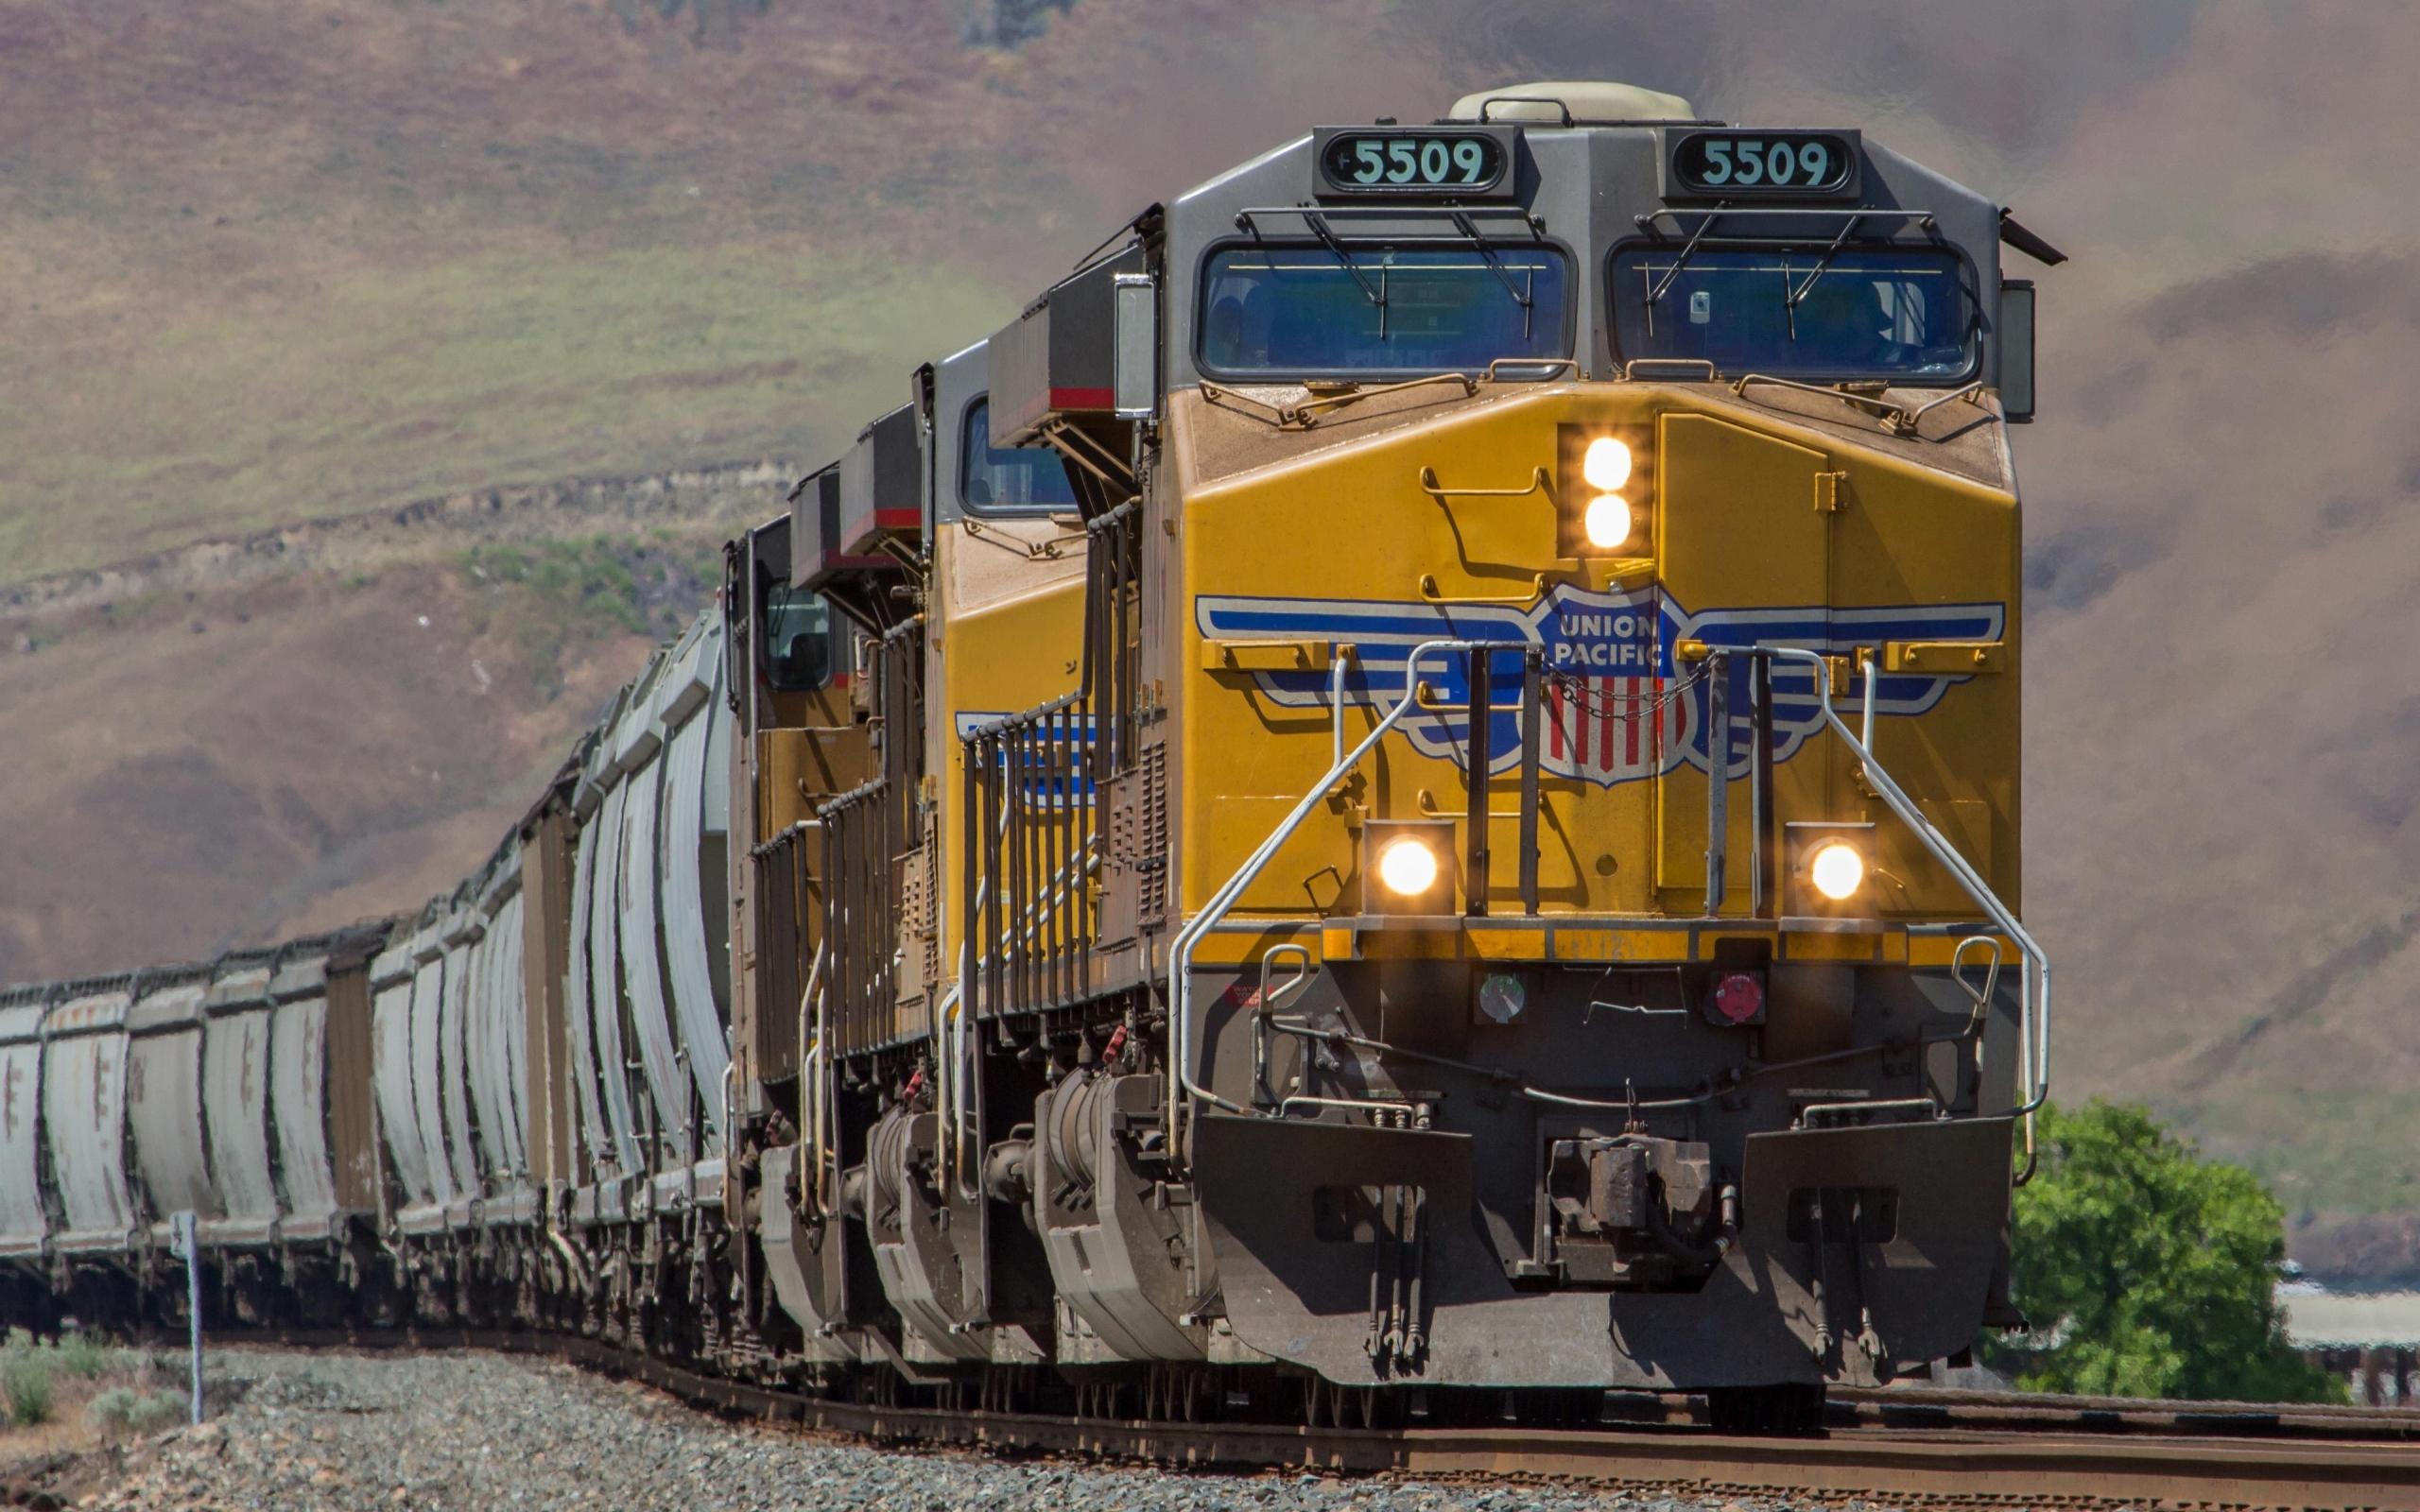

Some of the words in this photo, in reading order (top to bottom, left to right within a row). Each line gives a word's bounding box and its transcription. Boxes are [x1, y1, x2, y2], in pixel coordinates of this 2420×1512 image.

[1354, 140, 1482, 183] 5509
[1703, 141, 1827, 185] 5509
[1561, 615, 1657, 638] UNION
[1555, 643, 1662, 666] PACIFIC
